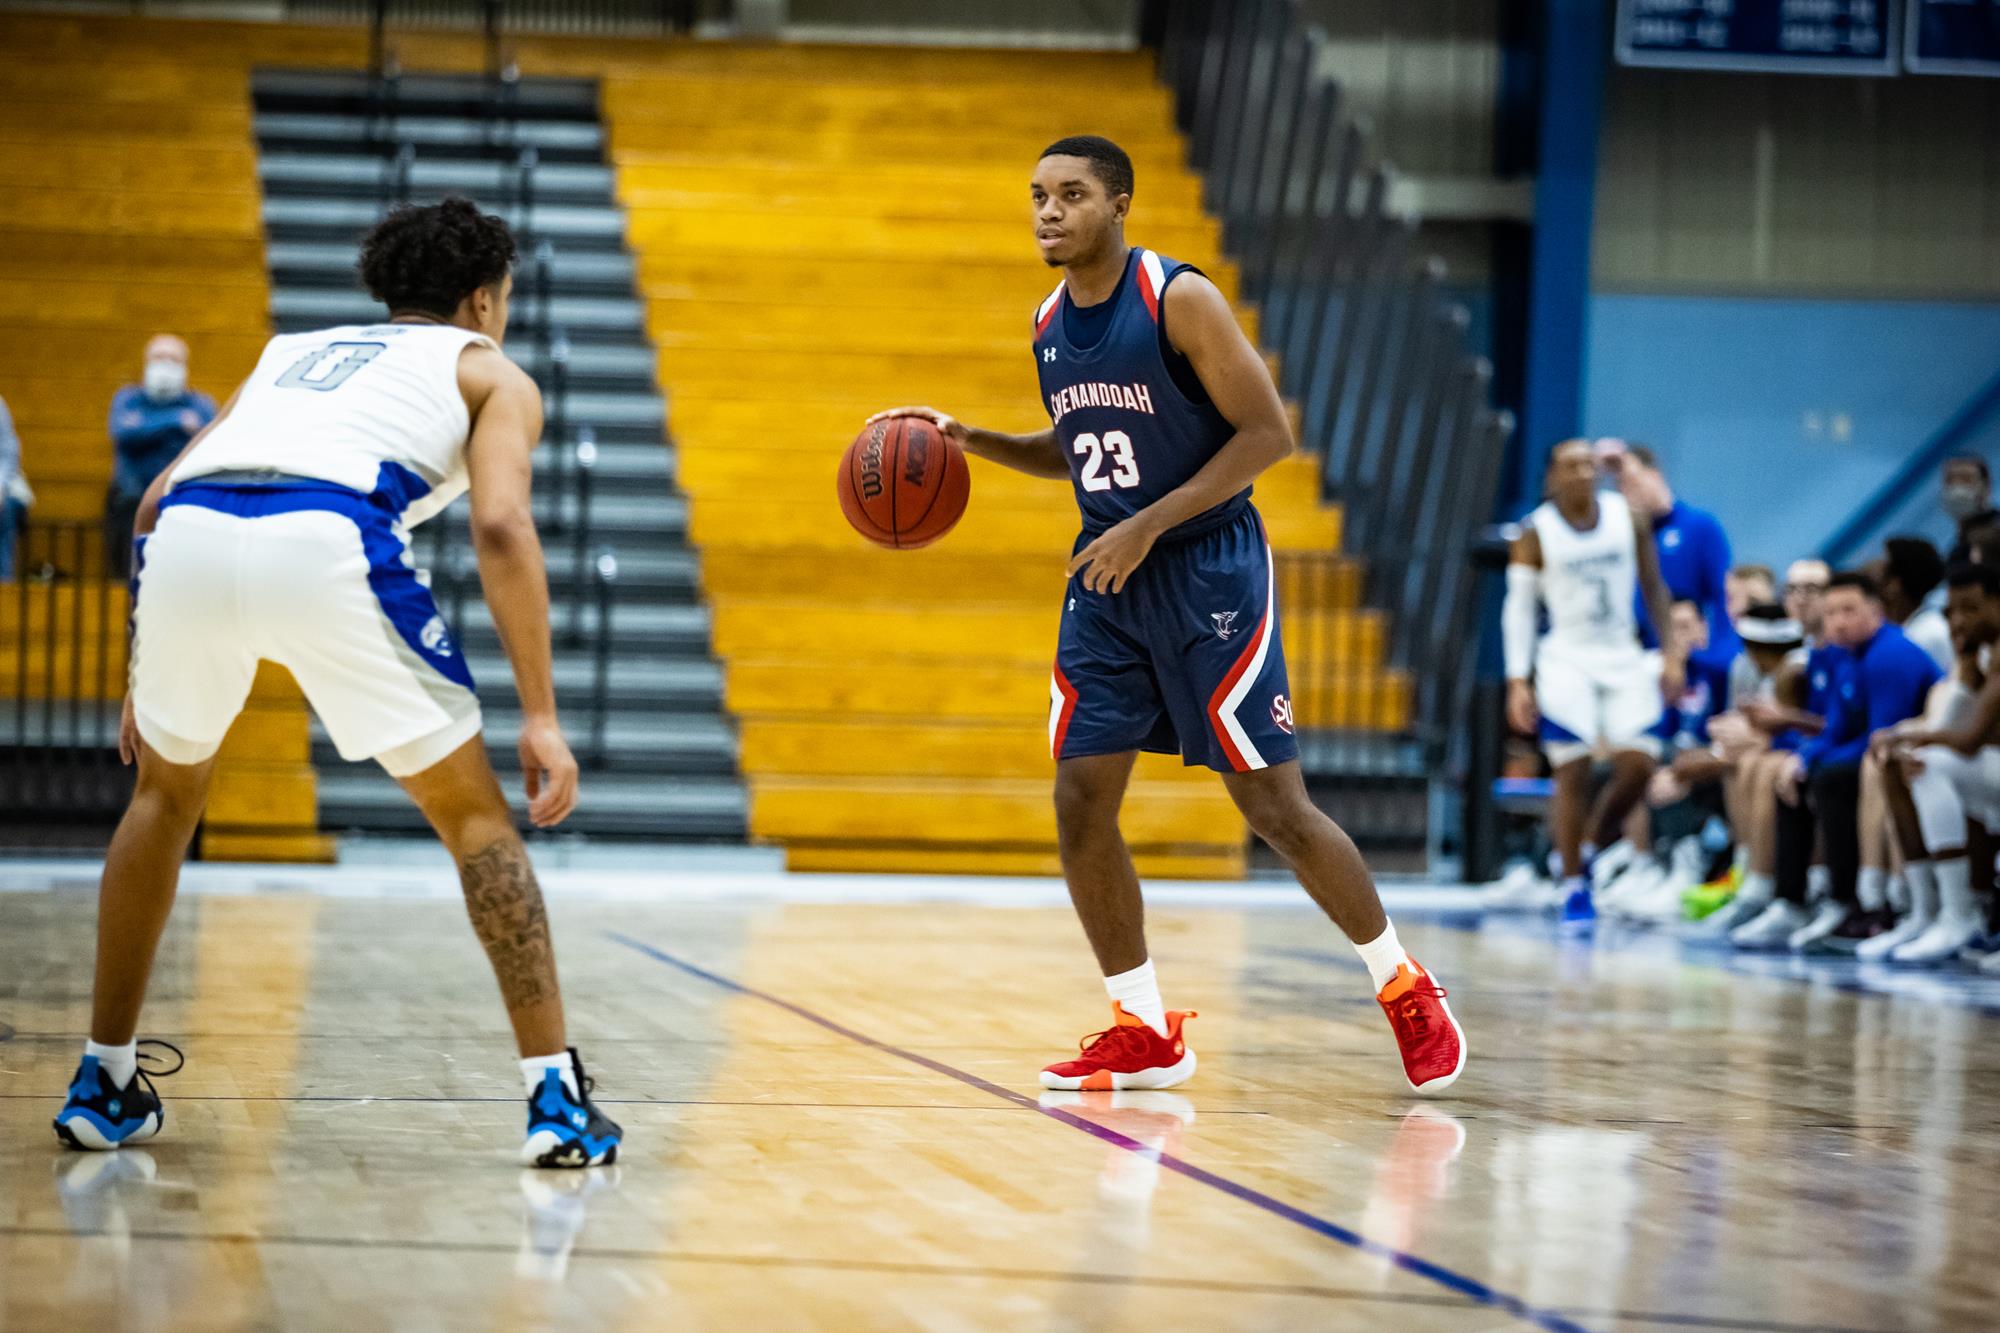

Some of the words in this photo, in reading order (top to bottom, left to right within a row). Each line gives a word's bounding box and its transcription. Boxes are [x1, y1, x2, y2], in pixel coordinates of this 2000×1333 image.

[274, 341, 388, 392] 0
[1050, 382, 1155, 426] SHENANDOAH
[1073, 430, 1140, 493] 23
[1273, 694, 1294, 726] SU
